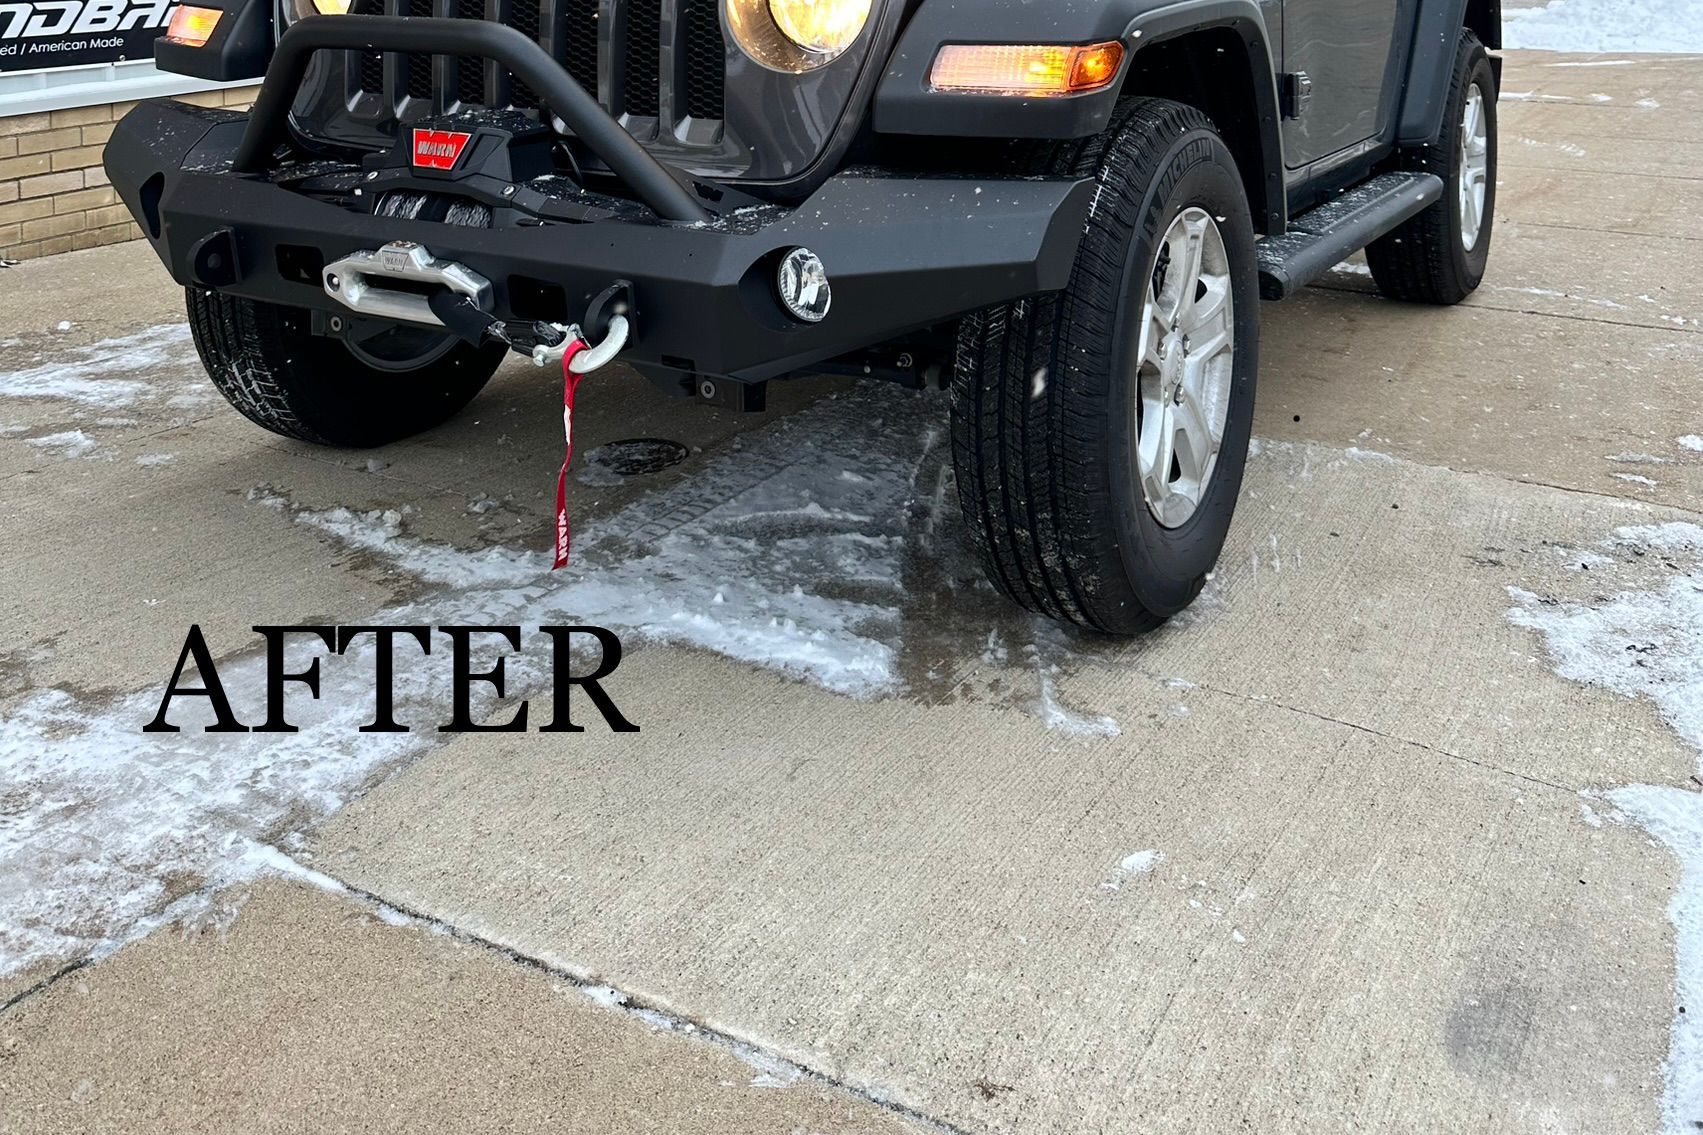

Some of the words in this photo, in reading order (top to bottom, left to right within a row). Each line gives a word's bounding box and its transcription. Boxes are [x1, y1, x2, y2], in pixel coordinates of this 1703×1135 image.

[28, 40, 87, 54] American
[90, 37, 125, 49] Made
[417, 141, 457, 158] WARN
[558, 508, 568, 562] WARN
